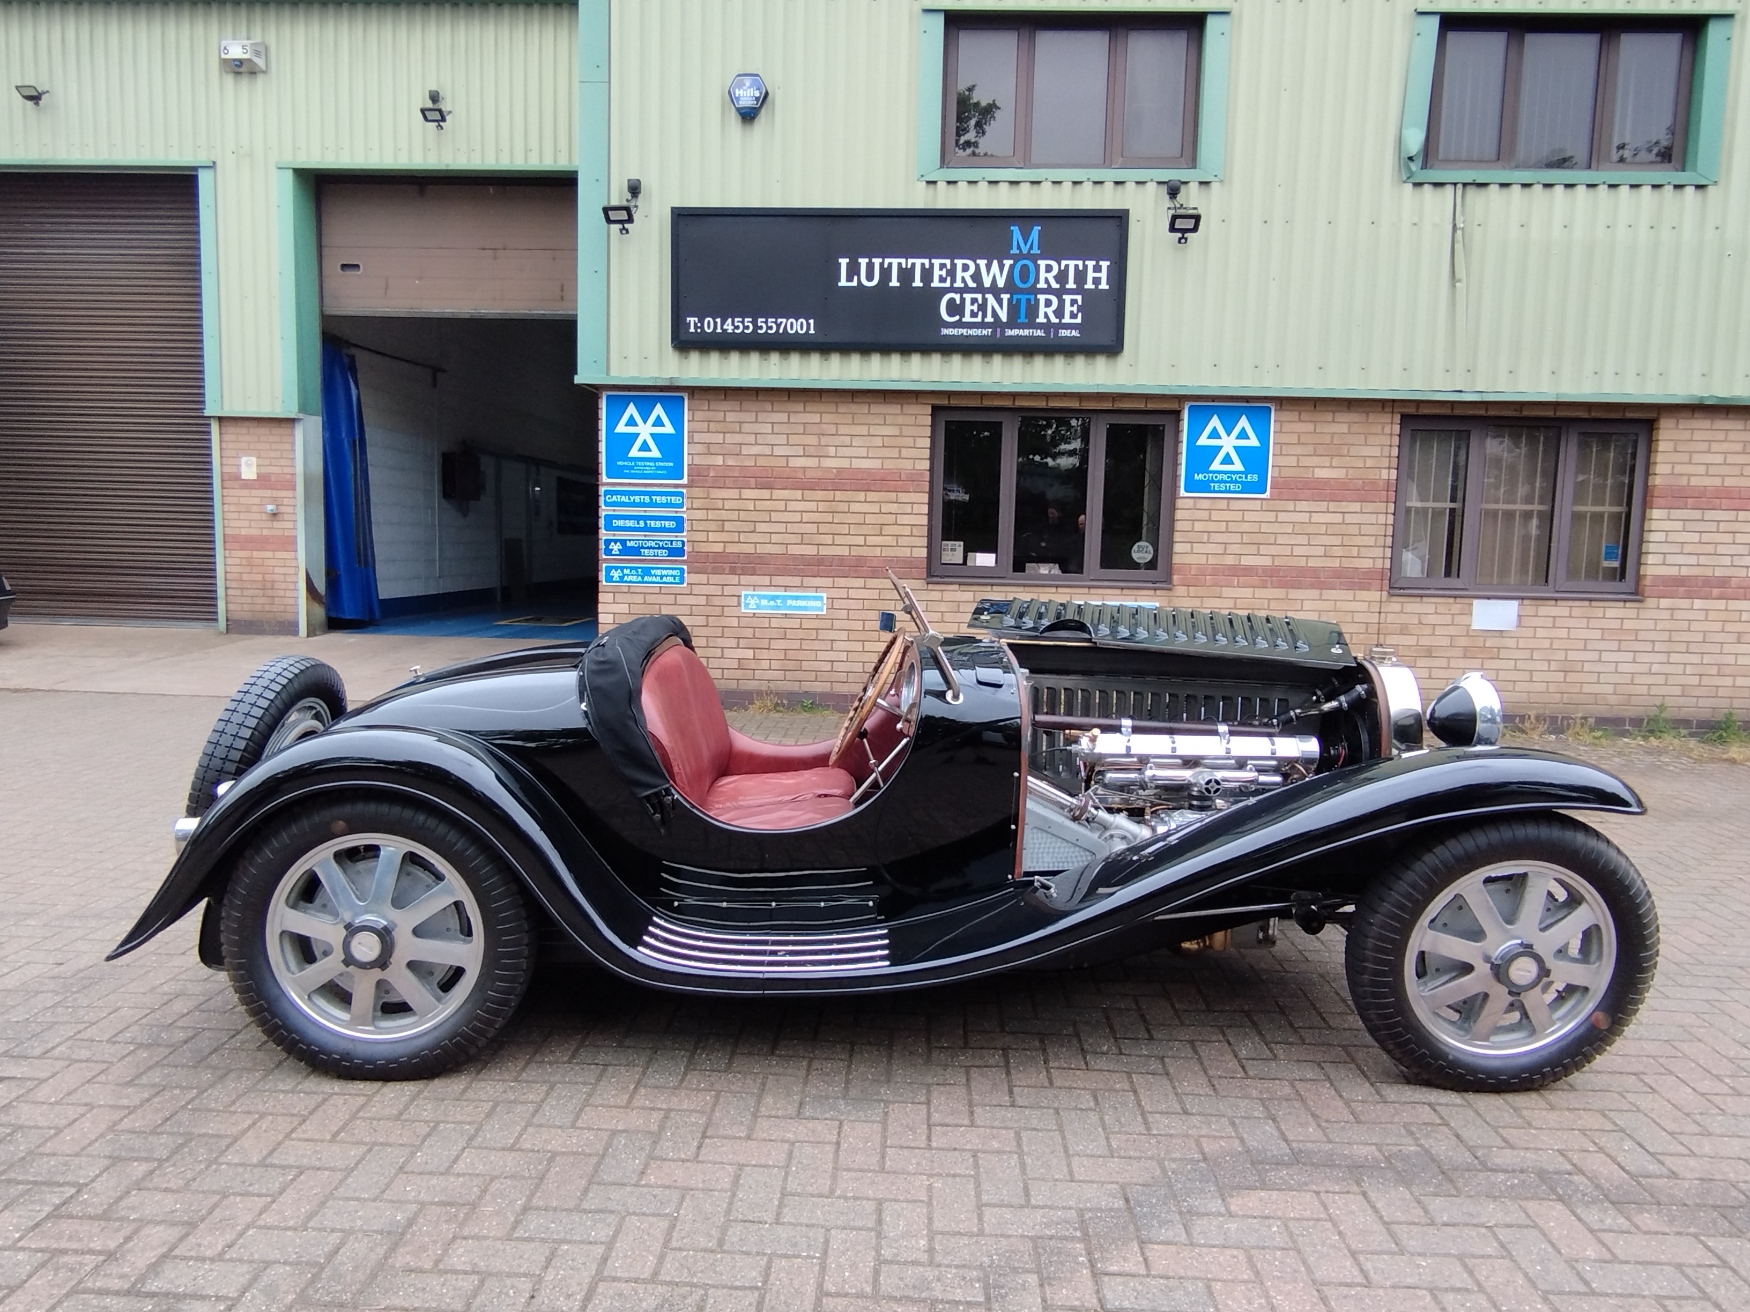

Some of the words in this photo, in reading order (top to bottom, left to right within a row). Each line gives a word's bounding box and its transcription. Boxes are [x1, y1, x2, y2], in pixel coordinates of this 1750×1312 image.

[222, 45, 230, 56] 6
[241, 45, 249, 55] 5
[837, 257, 1111, 289] LUTTERWORTH
[939, 292, 1083, 323] CENTRE
[686, 316, 701, 333] T:
[703, 316, 754, 334] 01455
[756, 317, 816, 334] 557001
[940, 327, 993, 337] INDEPENDENT
[1004, 328, 1046, 338] IMPARTIAL
[1058, 328, 1081, 337] IDEAL
[1194, 473, 1259, 482] MOTORCYCLES
[1209, 483, 1242, 491] TESTED
[605, 494, 650, 503] CATALYSTS
[652, 495, 683, 504] TESTED
[612, 519, 645, 528] DIESELS
[646, 520, 676, 528] TESTED
[626, 540, 683, 548] MOTORCYCLES
[640, 548, 669, 557] TESTED
[623, 575, 643, 583] AREA
